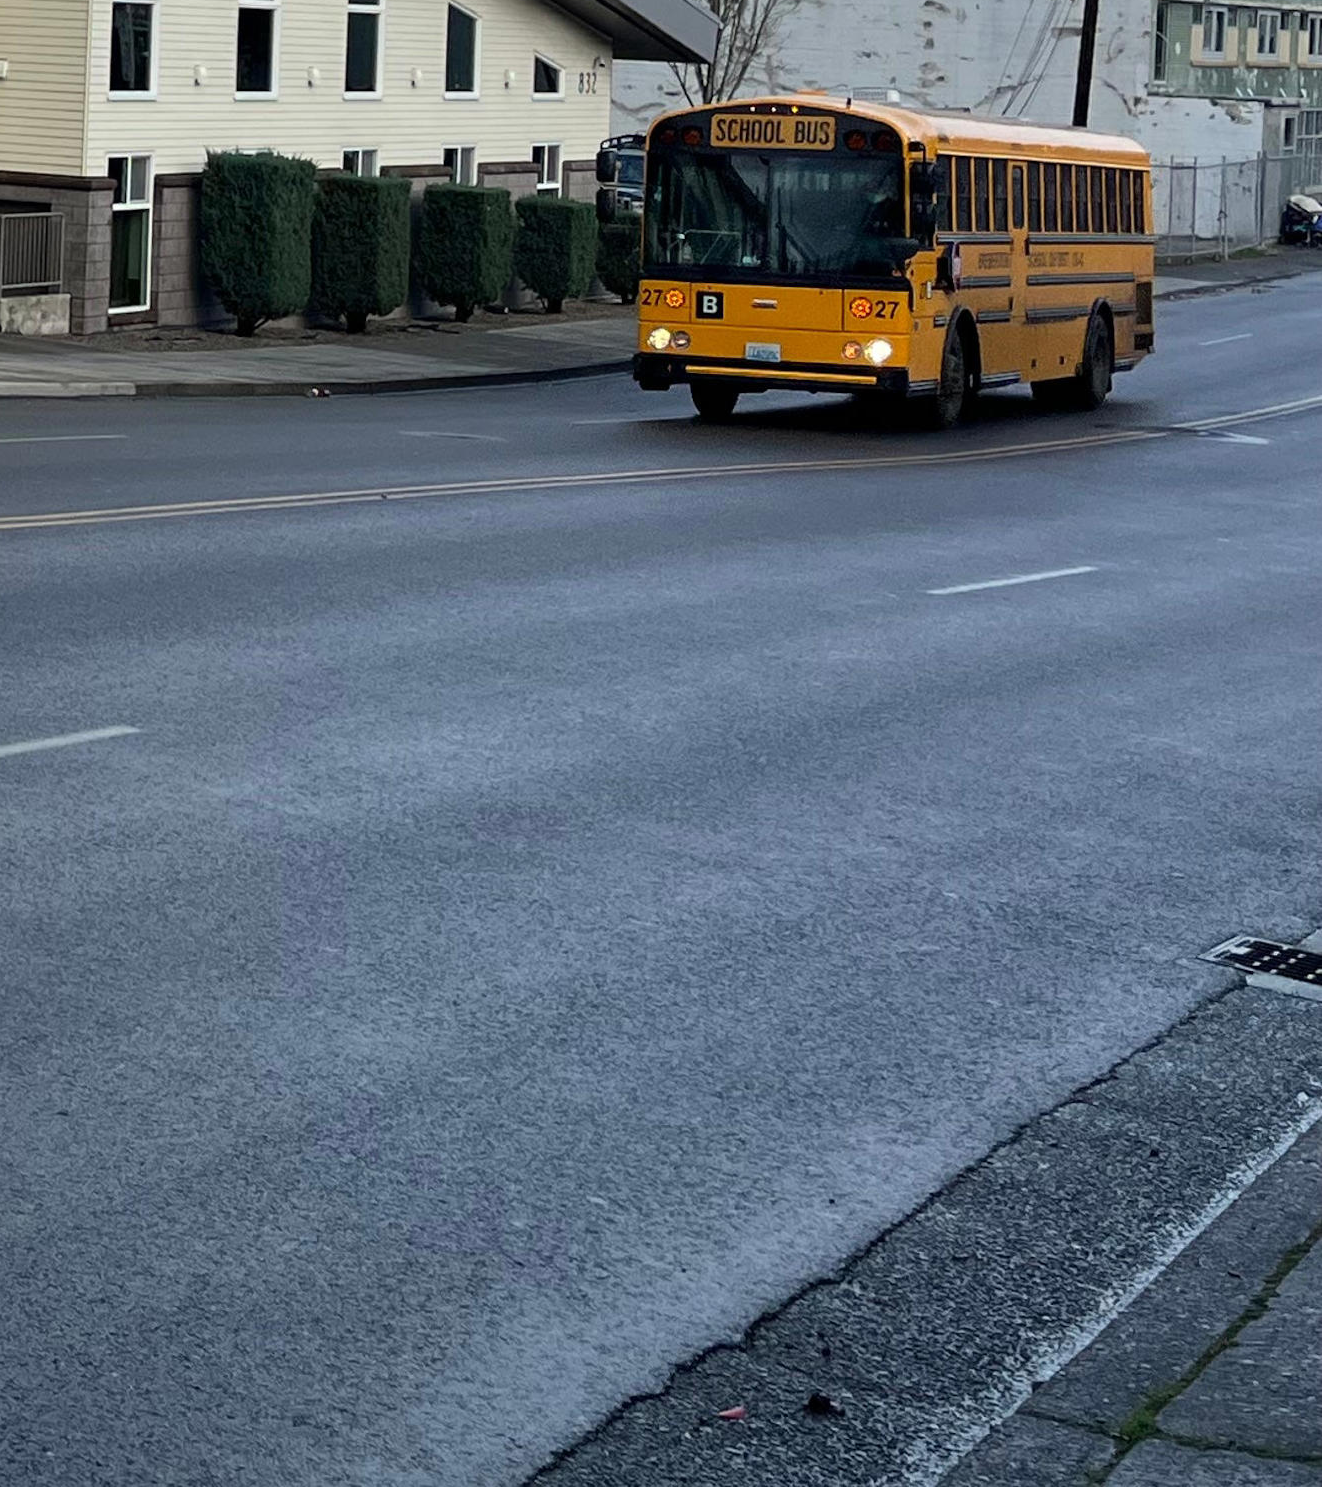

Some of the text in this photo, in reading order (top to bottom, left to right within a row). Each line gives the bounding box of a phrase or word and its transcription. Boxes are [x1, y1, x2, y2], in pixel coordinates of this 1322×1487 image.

[715, 118, 831, 145] SCHOOL BUS
[641, 288, 664, 306] 27
[702, 295, 718, 315] B
[874, 300, 900, 320] 27
